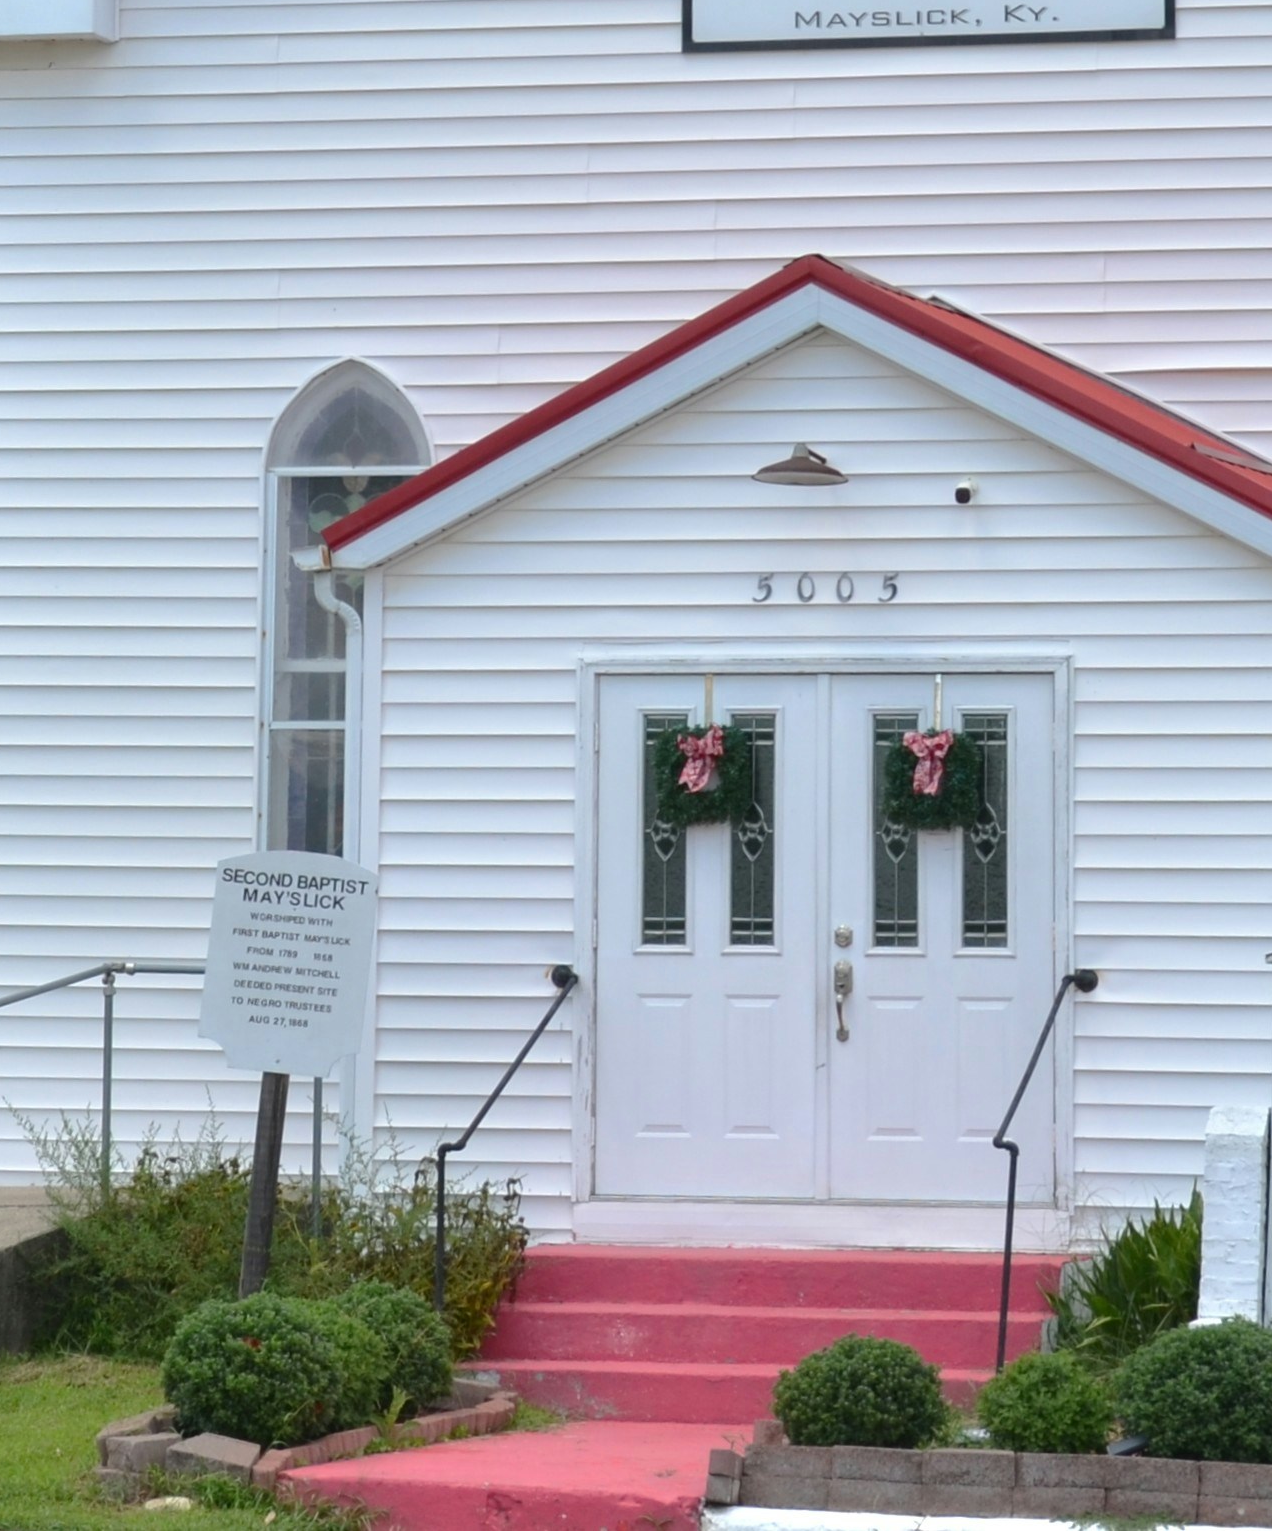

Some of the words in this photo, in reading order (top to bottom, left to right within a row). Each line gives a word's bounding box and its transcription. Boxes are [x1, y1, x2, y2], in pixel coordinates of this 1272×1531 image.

[794, 7, 983, 30] MAYSLICK,
[1003, 4, 1060, 23] KY.
[752, 572, 900, 603] 5005
[222, 868, 293, 888] SECOND
[297, 876, 369, 895] BAPTIST
[250, 912, 305, 925] WORSHIPED
[308, 918, 333, 927] WITH
[232, 928, 259, 937] FIRST
[262, 931, 300, 941] BAPTIST
[247, 947, 274, 956] FROM
[233, 962, 250, 971] WM
[251, 964, 292, 974] ANDREW
[295, 968, 340, 979] MITCHELL
[234, 980, 272, 991] DEEDED
[275, 983, 314, 994] PRESENT
[317, 987, 338, 997] SITE
[231, 996, 243, 1005] TO
[247, 998, 282, 1008] NEGRO
[285, 1001, 332, 1013] TRUSTEES
[249, 1015, 270, 1024] AUG
